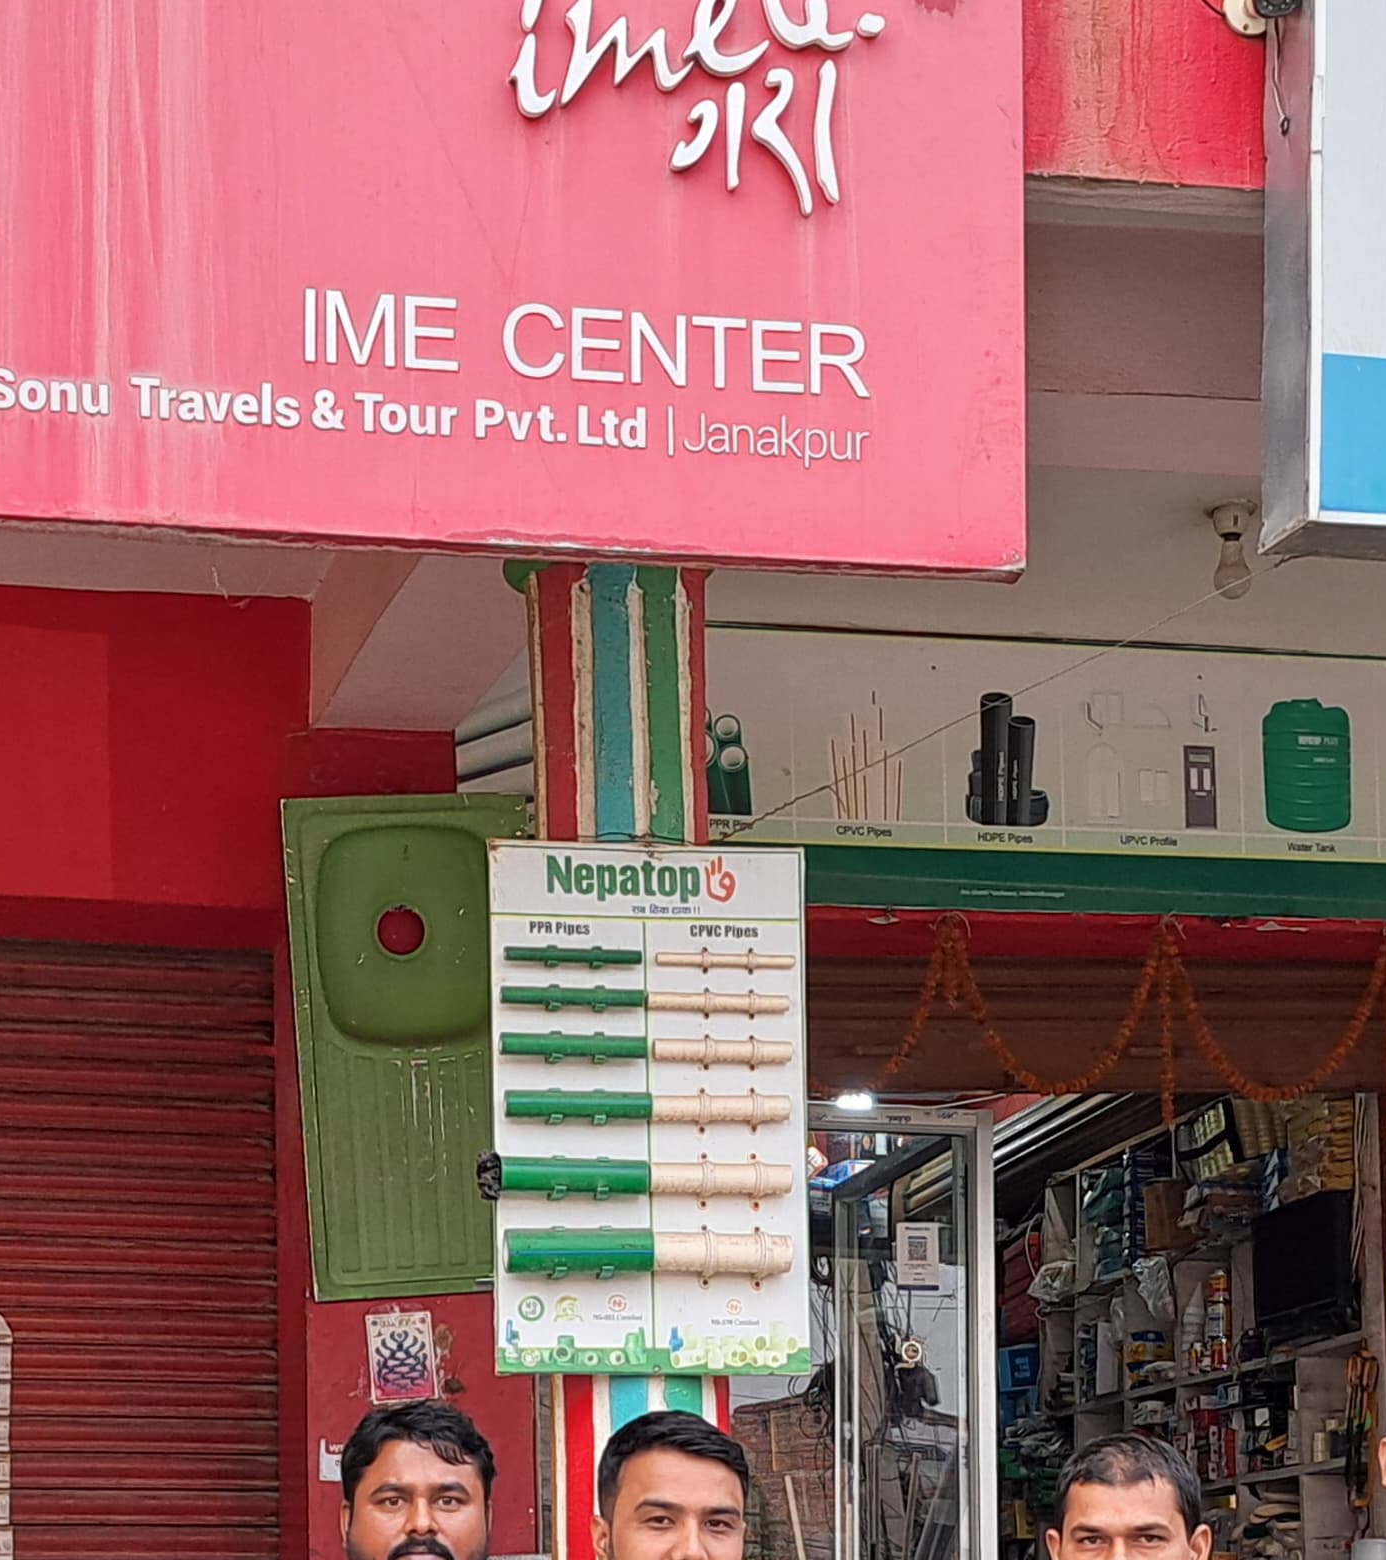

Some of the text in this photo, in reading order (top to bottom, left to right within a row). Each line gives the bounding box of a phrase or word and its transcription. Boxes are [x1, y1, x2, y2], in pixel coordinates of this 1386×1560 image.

[303, 287, 871, 399] IME CENTER
[129, 375, 301, 429] Travels
[311, 389, 346, 432] &
[354, 392, 459, 439] Tour
[473, 399, 568, 445] Pvt.
[576, 405, 647, 450] Ltd
[682, 412, 870, 469] Janakpur
[709, 818, 731, 830] PPR
[836, 825, 892, 838] CPVC Pipes
[977, 831, 1033, 845] HDPE Pipes
[1120, 834, 1178, 848] UPVC Profile
[1287, 841, 1337, 854] Water Tank
[546, 855, 701, 902] Nepatop
[529, 921, 591, 936] PPR Pipes
[689, 924, 759, 938] CPVC Pipes
